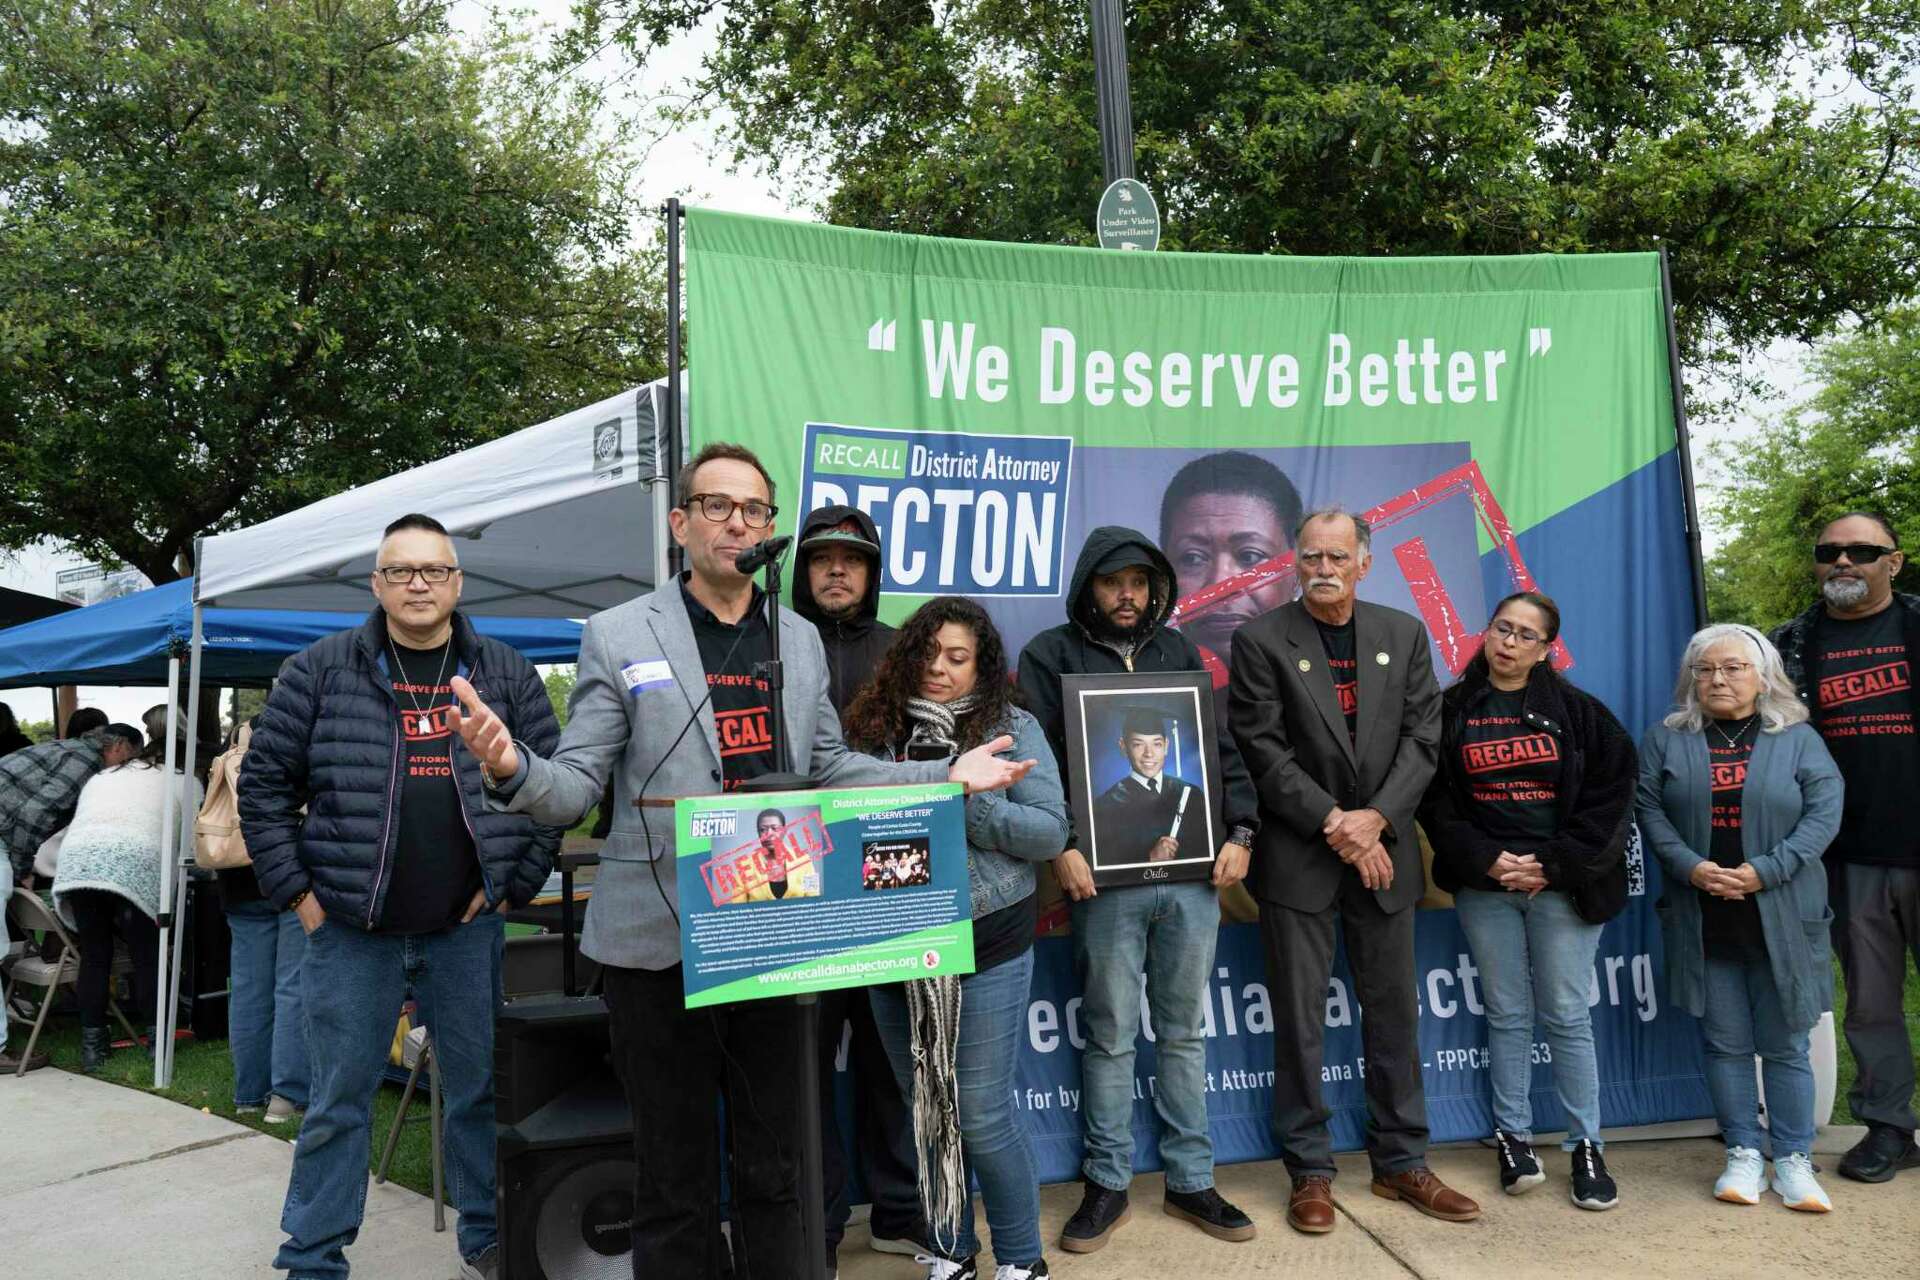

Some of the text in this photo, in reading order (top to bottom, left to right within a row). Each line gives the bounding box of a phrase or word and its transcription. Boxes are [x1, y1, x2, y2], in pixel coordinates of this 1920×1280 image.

[1130, 217, 1155, 225] Video
[1103, 228, 1154, 237] Surveillance
[921, 320, 1010, 403] We
[1040, 327, 1300, 408] Deserve
[1324, 333, 1506, 407] Better
[819, 437, 1060, 485] RECALL District Attorney
[706, 673, 752, 686] ESERVE
[1820, 667, 1907, 703] RECALL
[1858, 713, 1912, 723] ATTORNEY
[1861, 725, 1914, 735] BECTON
[408, 755, 449, 764] ATTORN
[1469, 738, 1552, 767] RECALL
[409, 766, 451, 776] BECTO
[832, 799, 863, 809] District
[925, 793, 953, 804] Becton
[1511, 790, 1555, 800] BECTON
[872, 810, 904, 821] DESERVE
[692, 817, 736, 837] BECTON
[713, 825, 823, 894] RECALL
[758, 956, 918, 984] www.recalldianabecton.org
[1025, 1087, 1052, 1111] for
[1059, 1085, 1080, 1112] by
[1222, 1069, 1275, 1091] Attorn
